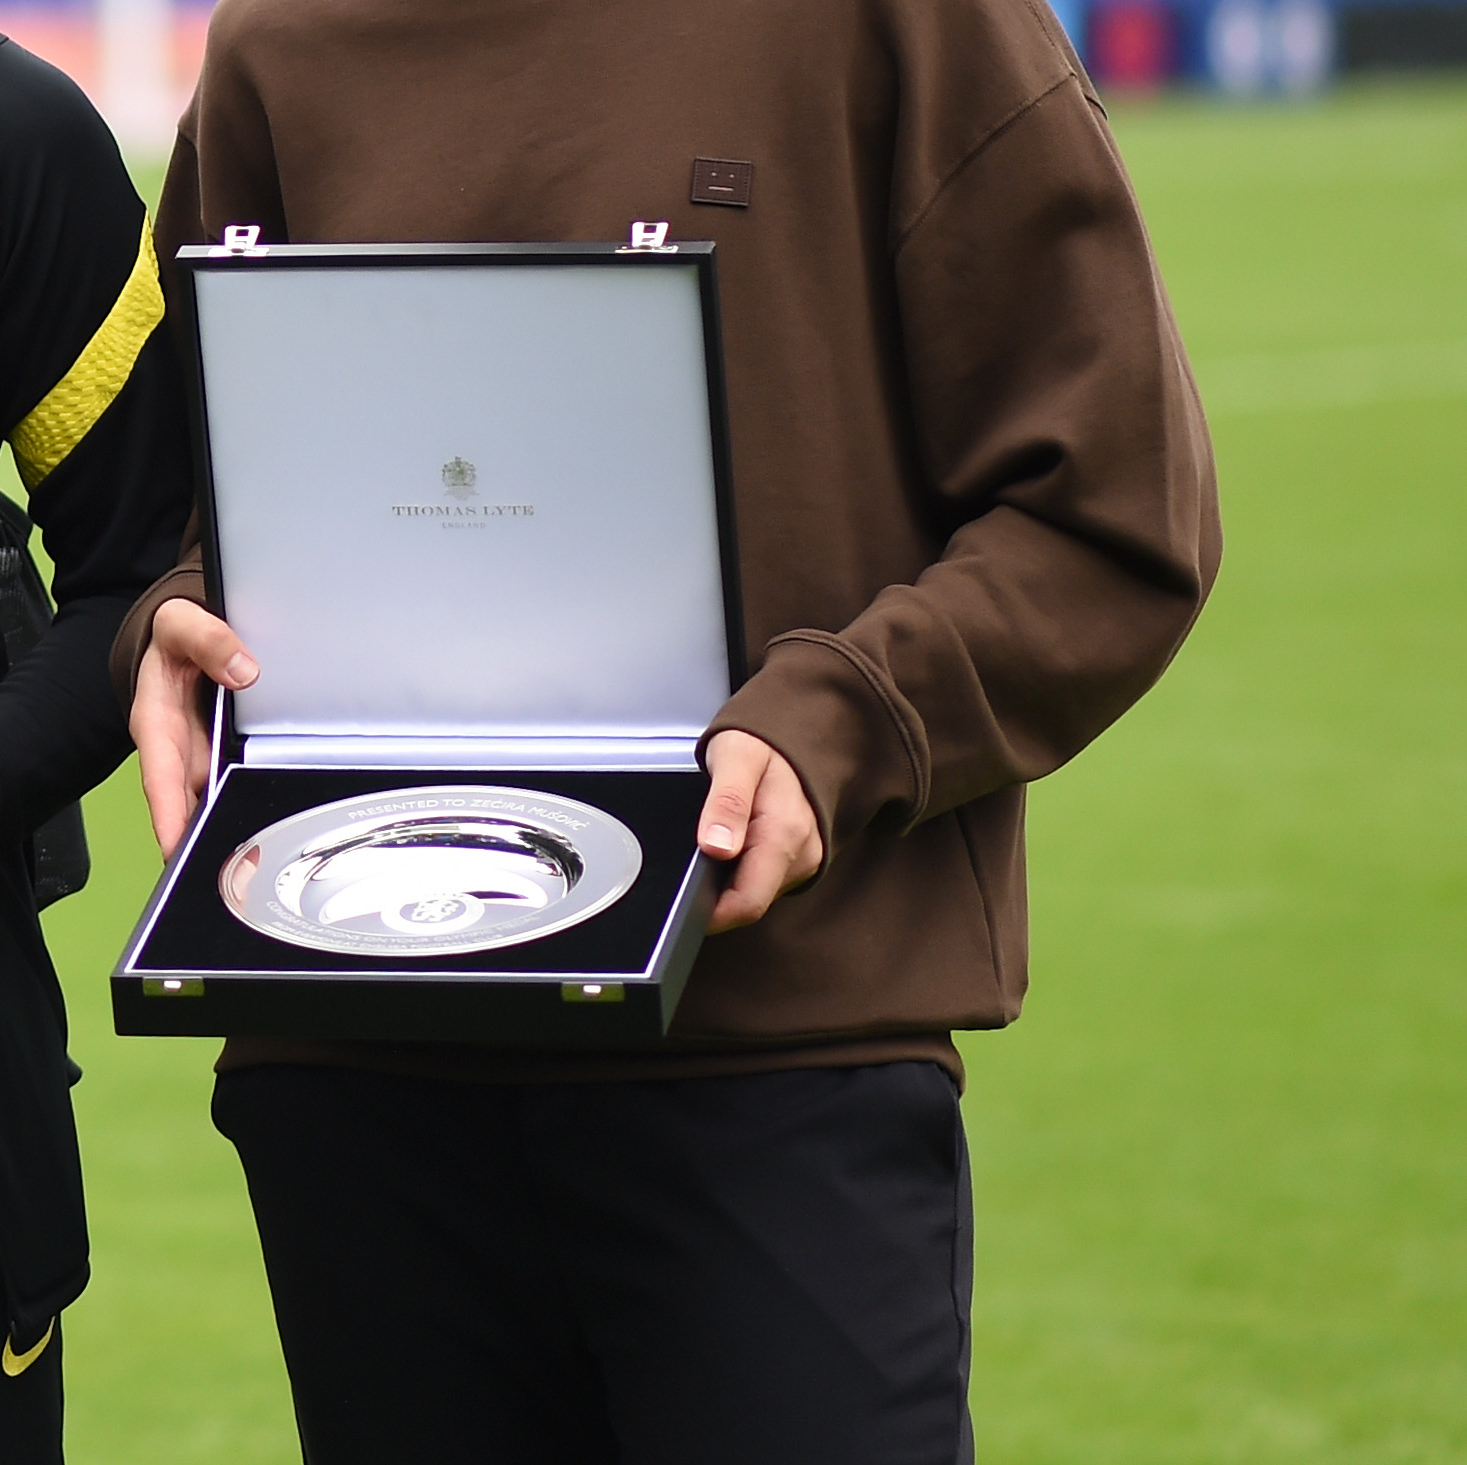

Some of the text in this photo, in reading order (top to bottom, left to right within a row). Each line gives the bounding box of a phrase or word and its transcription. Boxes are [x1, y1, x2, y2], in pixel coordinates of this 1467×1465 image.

[392, 504, 535, 517] THOMAS LYTE
[349, 799, 439, 820] PRESENTED
[442, 798, 466, 808] TO
